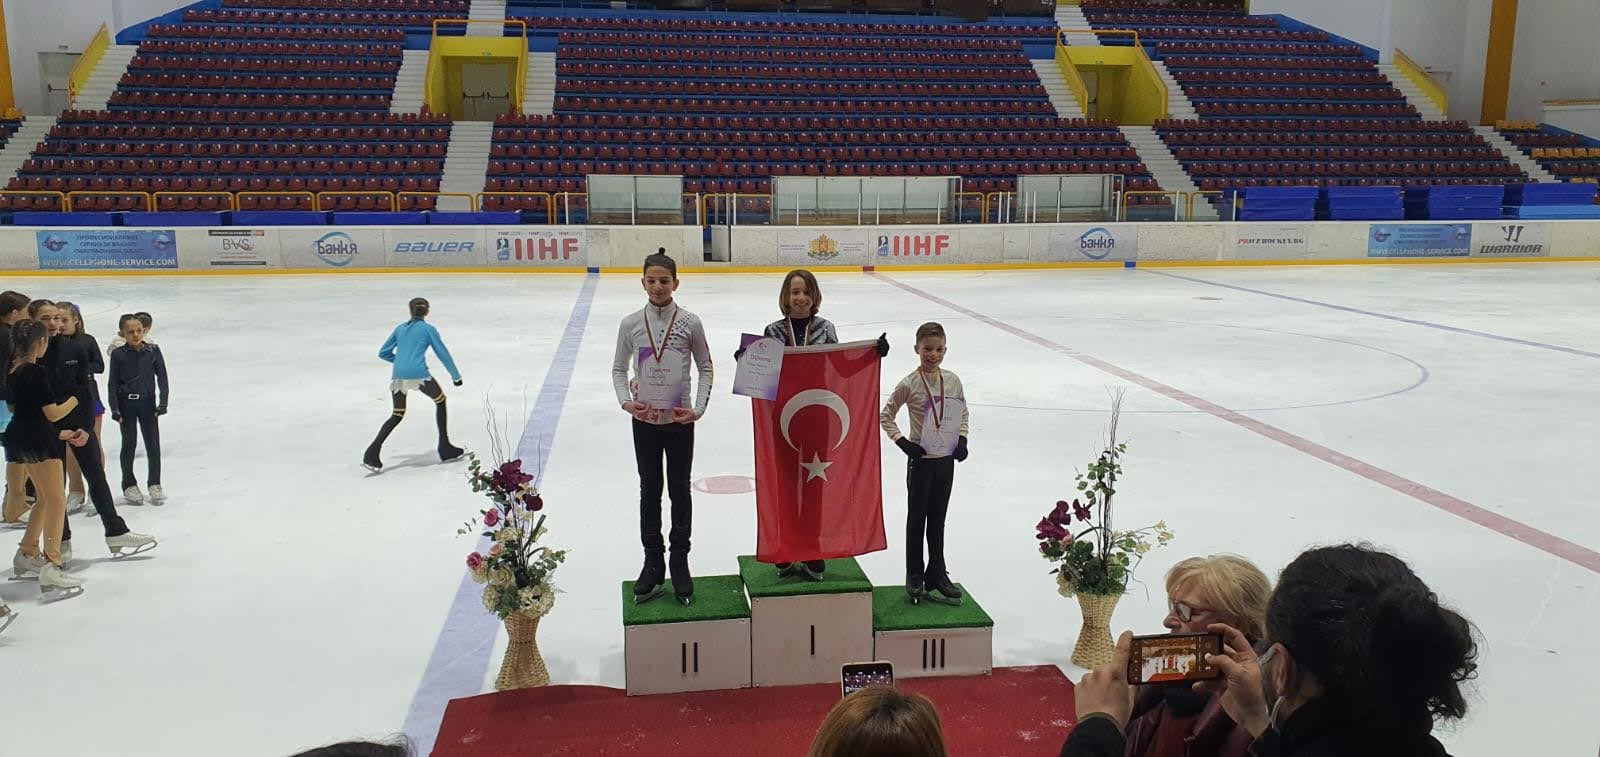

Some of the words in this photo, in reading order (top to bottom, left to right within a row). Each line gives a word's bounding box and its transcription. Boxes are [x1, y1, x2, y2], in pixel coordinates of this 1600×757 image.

[222, 238, 250, 250] BVS
[394, 241, 475, 253] BAUER
[514, 238, 579, 260] IIHF
[893, 235, 949, 256] IIHF
[1480, 244, 1543, 253] WARRIOR
[42, 258, 176, 266] WWW.CELLPHONE-SERVICE.COM
[682, 642, 698, 674] II
[922, 638, 945, 669] III
